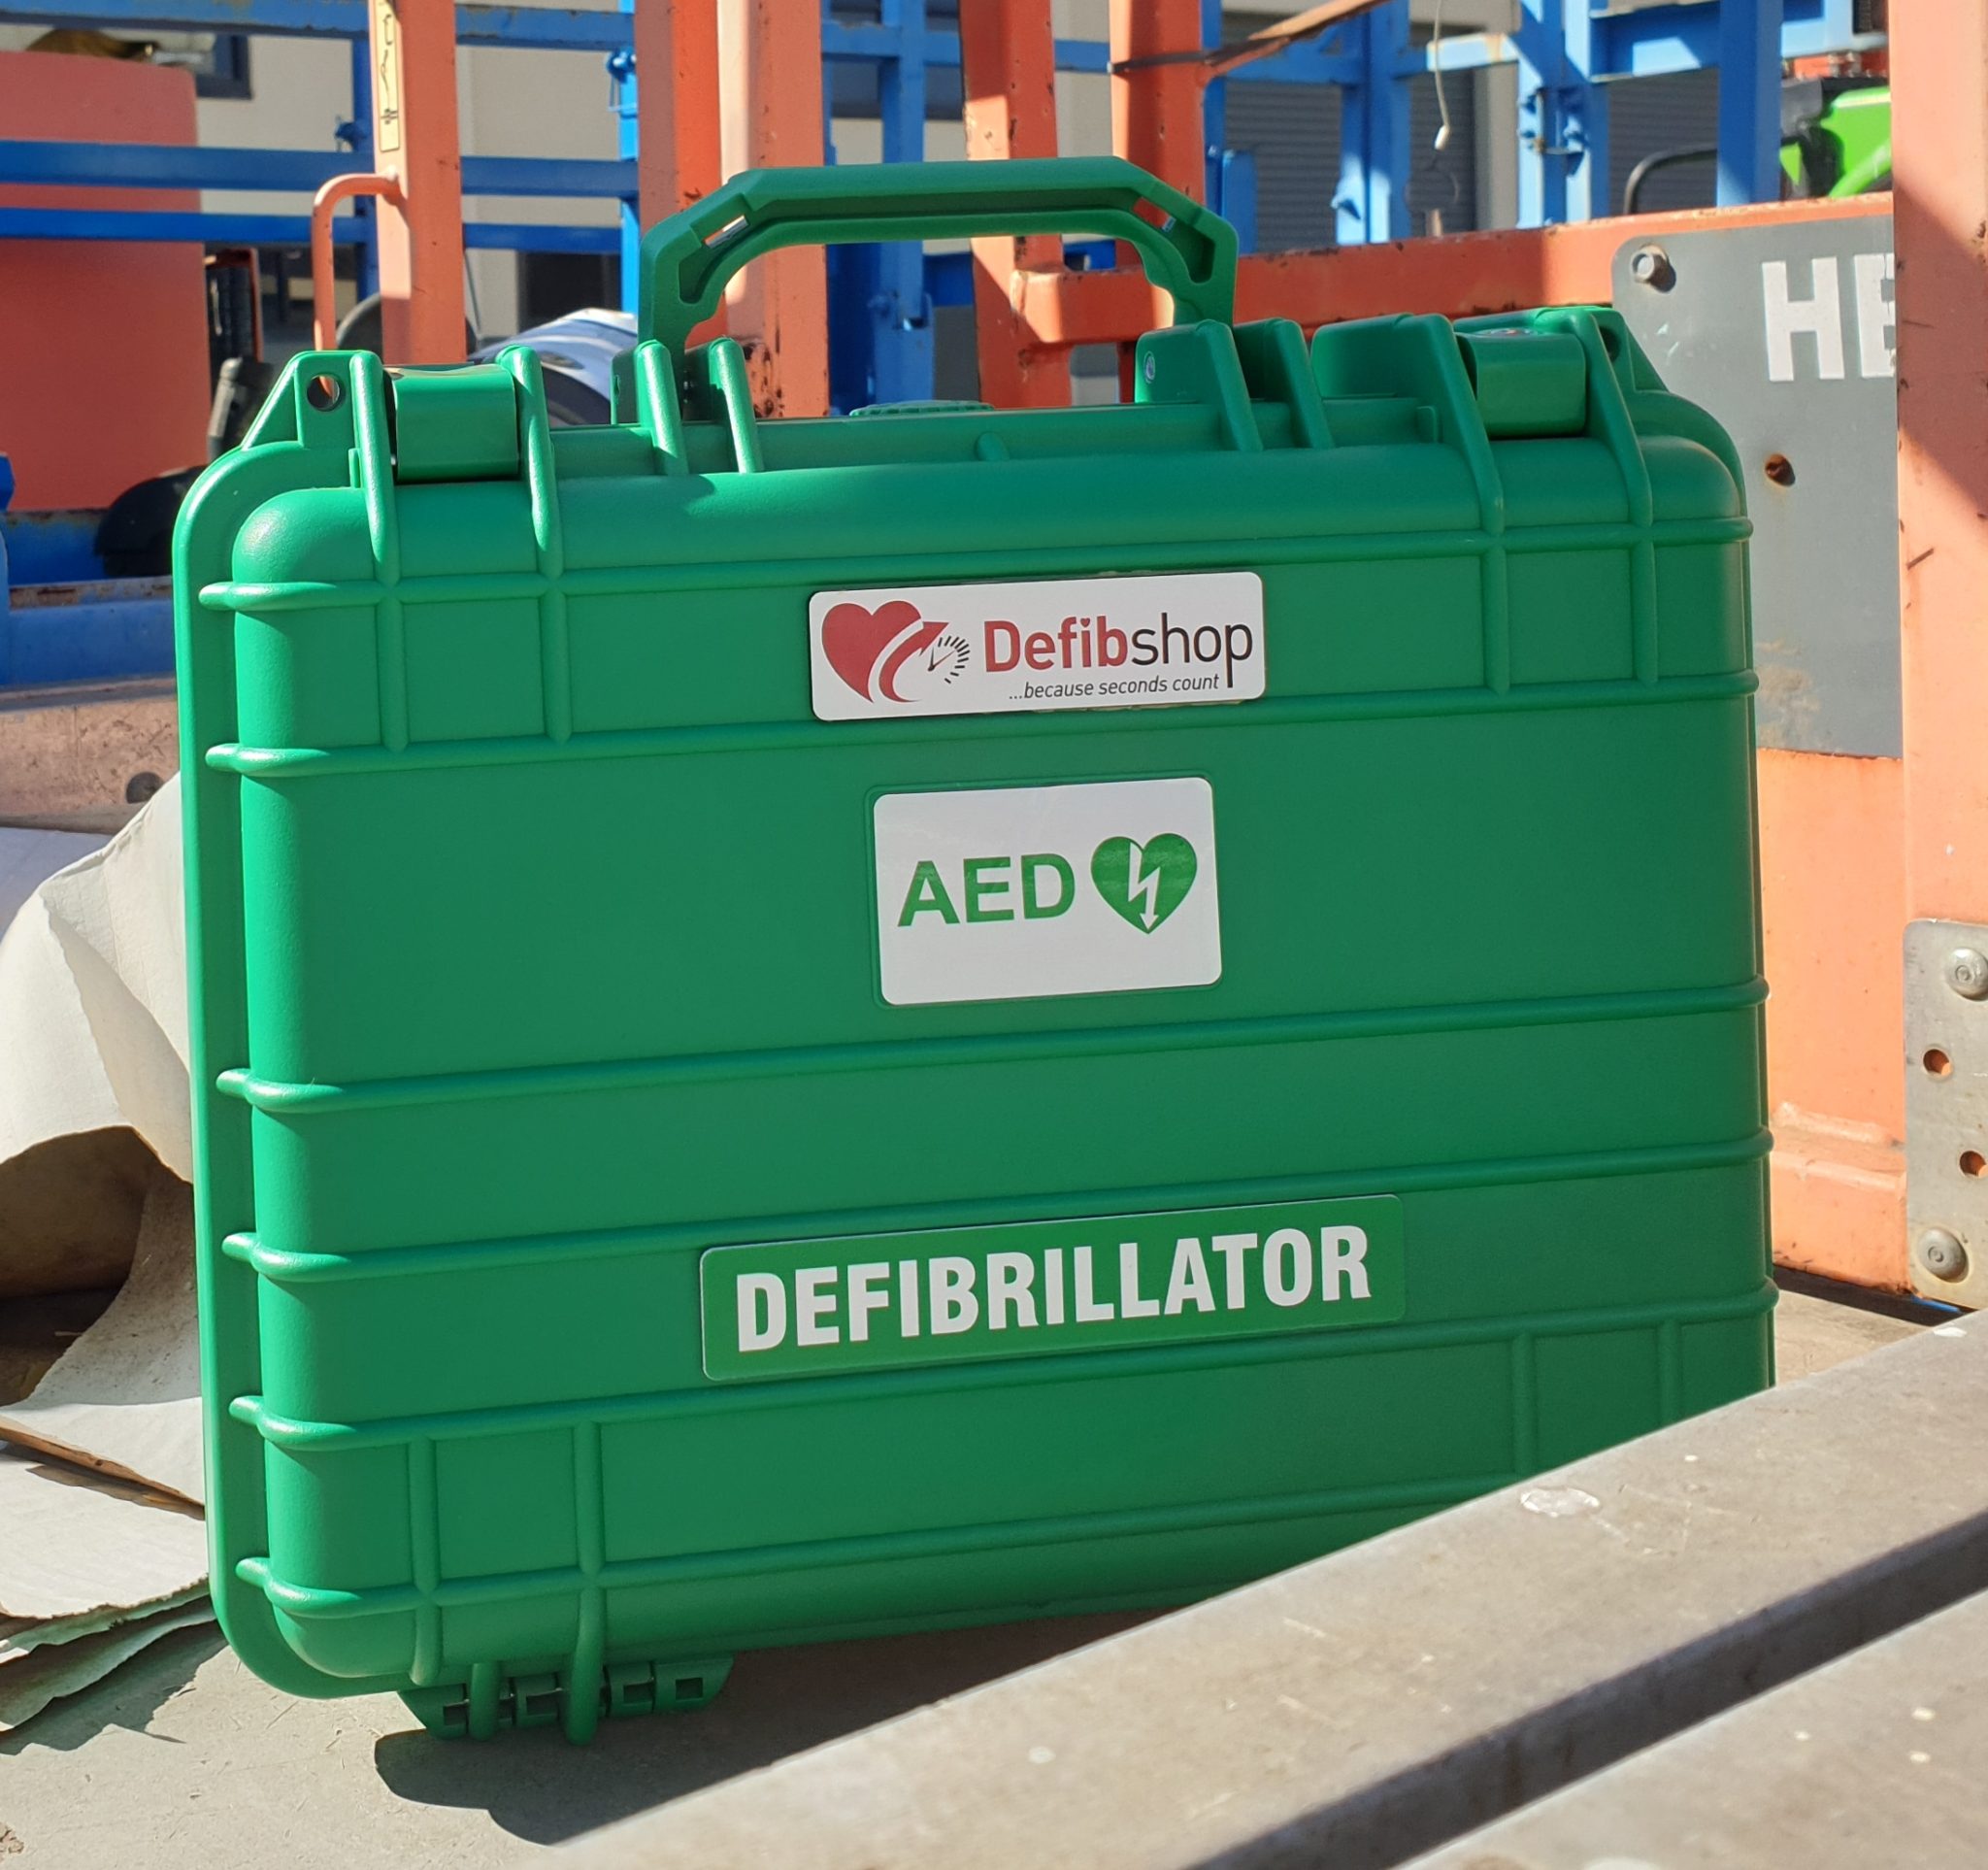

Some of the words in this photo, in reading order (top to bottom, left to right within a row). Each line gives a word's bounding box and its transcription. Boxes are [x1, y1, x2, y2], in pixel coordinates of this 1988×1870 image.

[984, 613, 1252, 688] Defibshop
[1009, 682, 1094, 700] ...because
[1098, 675, 1168, 695] seconds
[1173, 673, 1219, 691] count
[898, 853, 1076, 927] AED
[737, 1224, 1372, 1352] DEFIBRILLATOR
